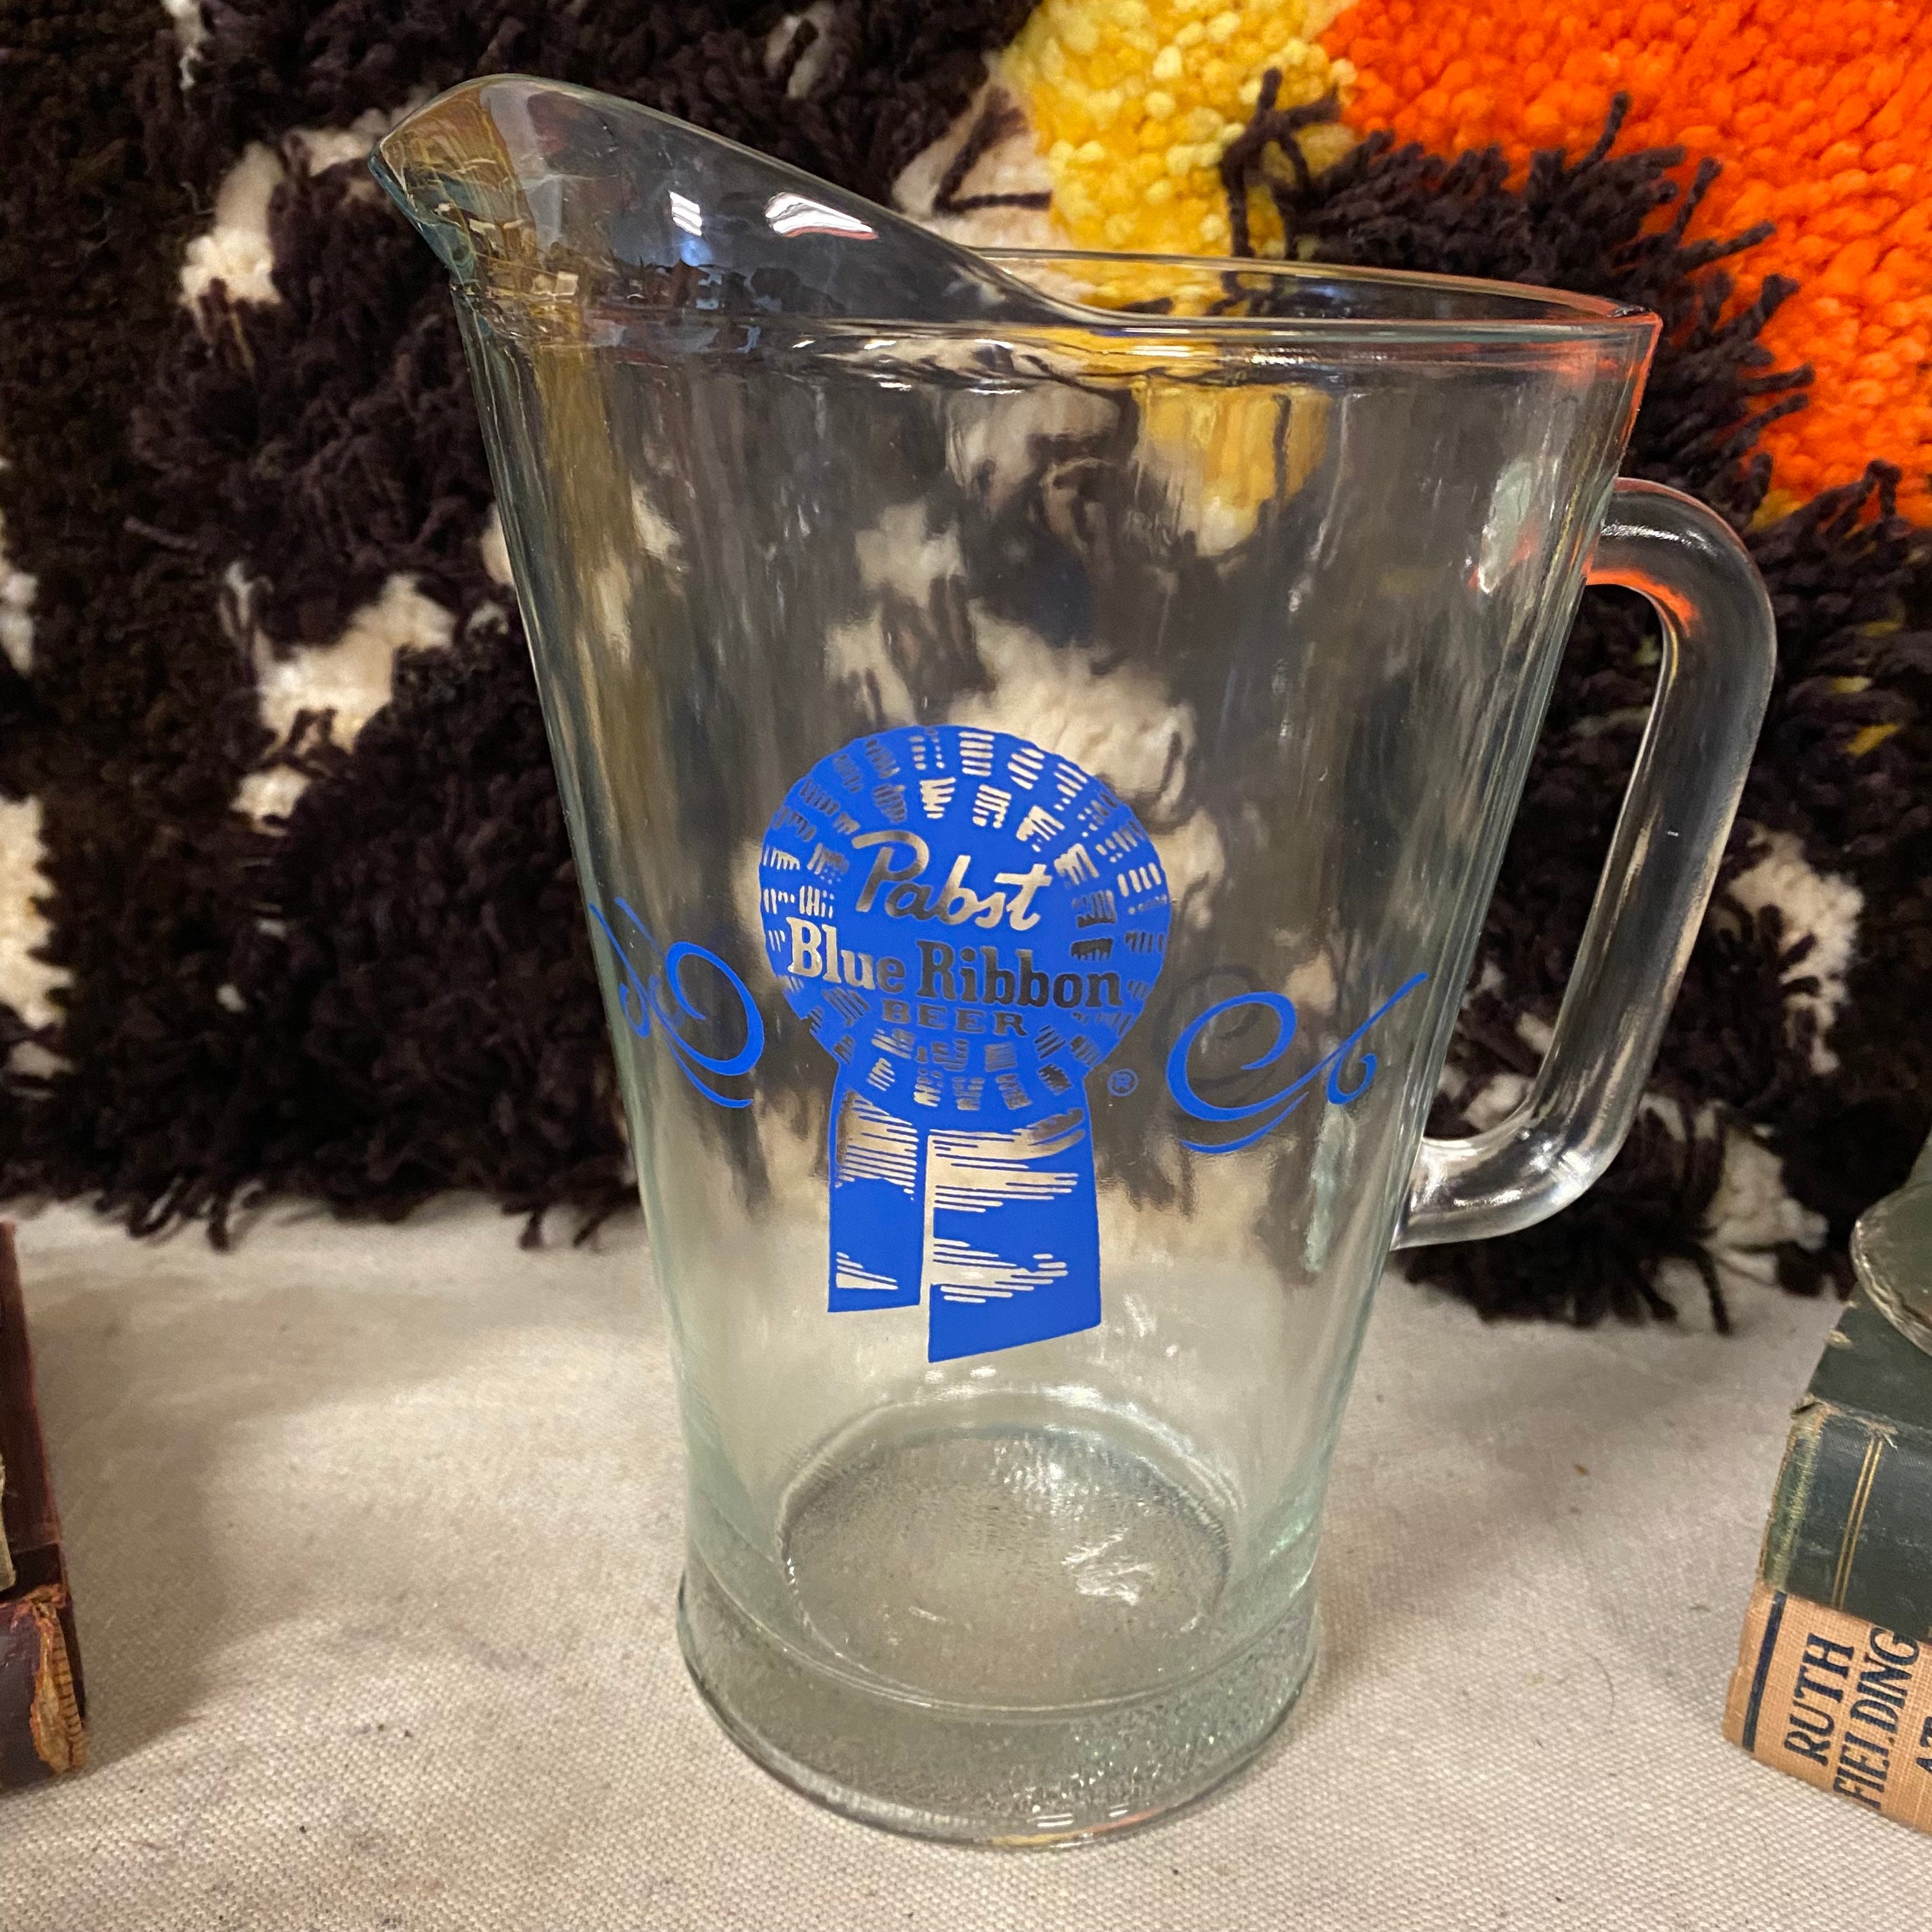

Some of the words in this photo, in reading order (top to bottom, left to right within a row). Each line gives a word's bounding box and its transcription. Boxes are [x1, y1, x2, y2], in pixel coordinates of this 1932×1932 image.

[851, 829, 1052, 931] Pabst
[786, 916, 906, 993] Blue
[916, 940, 1123, 1009] Ribbon
[882, 999, 1027, 1036] BEER
[1783, 1632, 1855, 1766] RUTH
[1833, 1627, 1920, 1810] FIELDING
